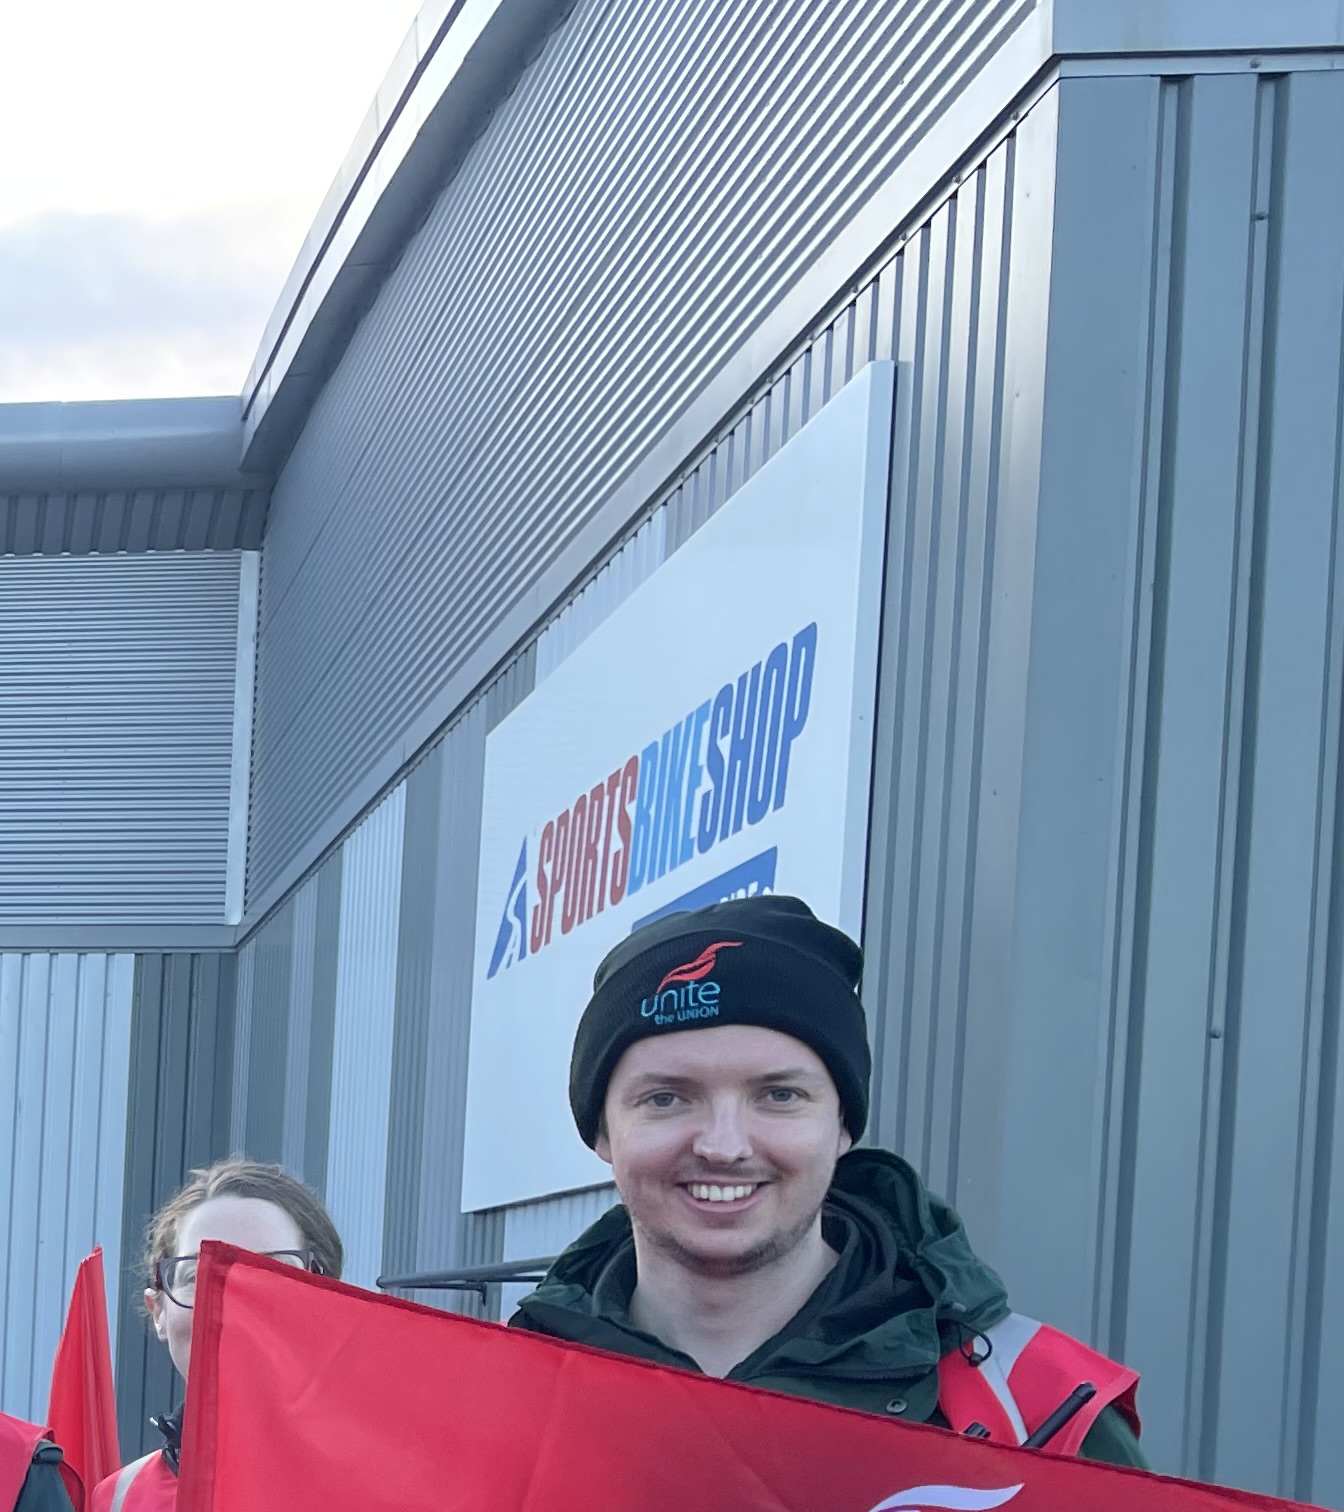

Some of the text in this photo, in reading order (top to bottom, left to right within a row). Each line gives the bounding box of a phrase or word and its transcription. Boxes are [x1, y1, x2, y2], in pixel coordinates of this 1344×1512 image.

[530, 622, 818, 954] SPORTSBIKESHOP
[640, 980, 721, 1017] unite
[677, 1005, 719, 1021] UNION
